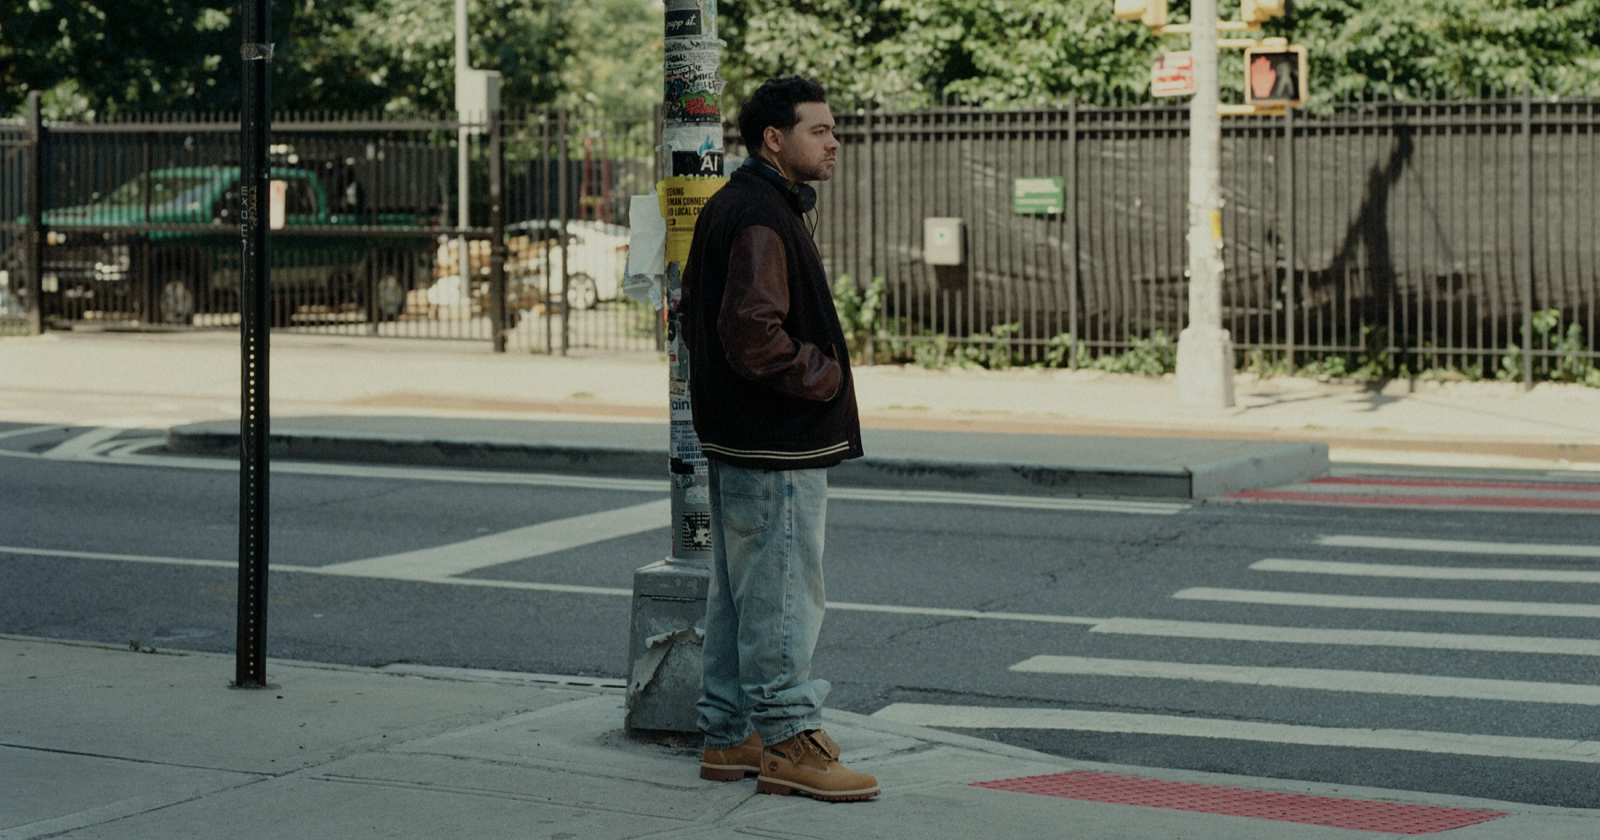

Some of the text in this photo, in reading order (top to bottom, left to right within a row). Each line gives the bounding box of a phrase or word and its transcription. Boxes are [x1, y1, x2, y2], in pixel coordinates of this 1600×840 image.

[685, 14, 697, 26] st.
[685, 96, 706, 108] BAD
[700, 155, 718, 171] AI
[666, 187, 684, 196] EEKING
[666, 197, 682, 206] UMAN
[674, 207, 692, 216] LOCAL
[671, 398, 691, 411] ain
